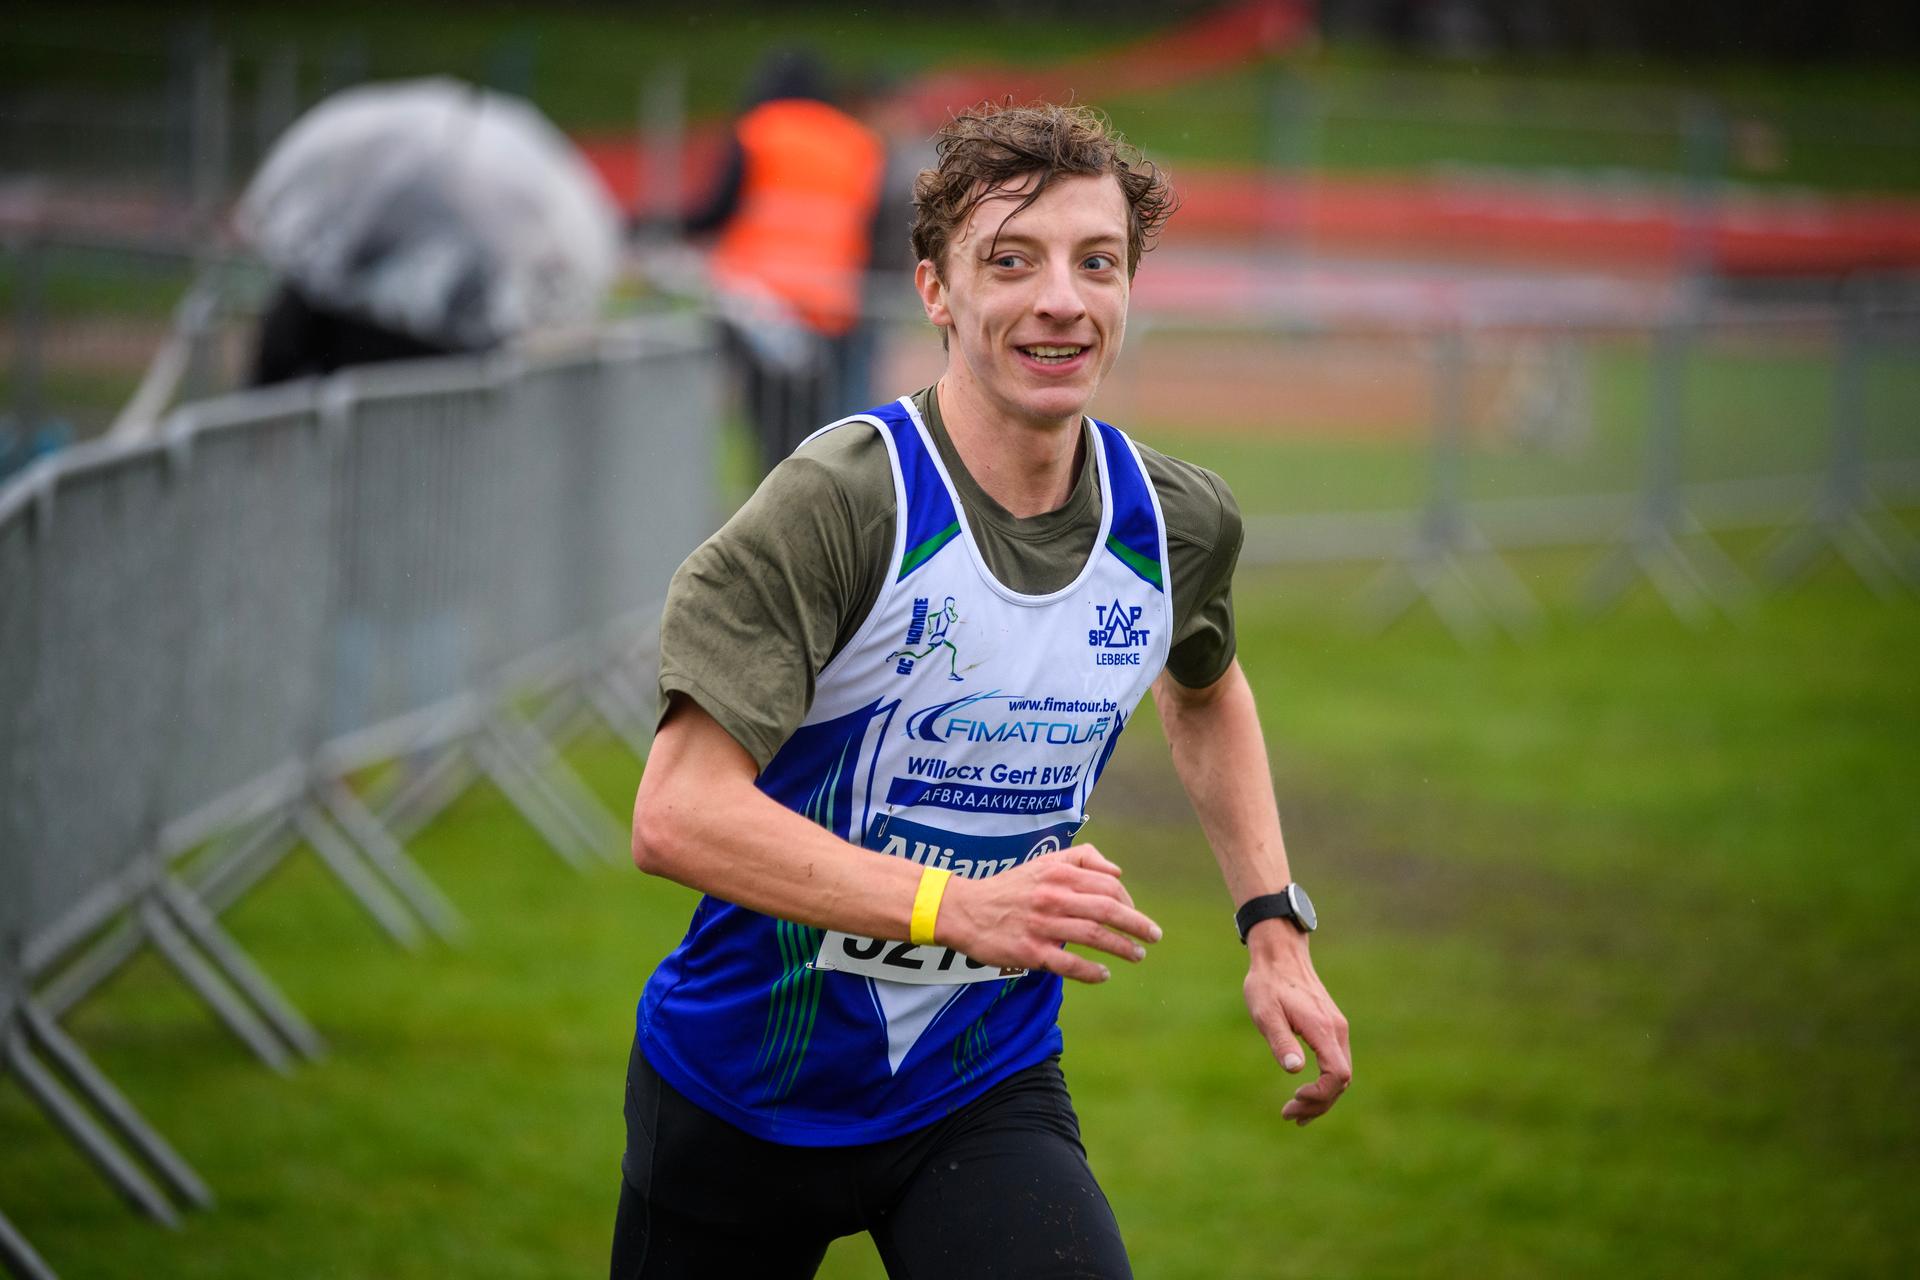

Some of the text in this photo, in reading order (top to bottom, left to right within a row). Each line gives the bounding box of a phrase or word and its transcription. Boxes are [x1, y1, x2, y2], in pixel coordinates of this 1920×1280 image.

[905, 597, 928, 645] HAMME
[1096, 653, 1140, 665] LEBBEKE
[1009, 697, 1117, 713] www.fimatour.be
[945, 718, 1107, 744] FIMATOUR
[907, 756, 1081, 785] Willocx Gert BVBA
[918, 788, 1061, 810] AFBRAAKWERKEN
